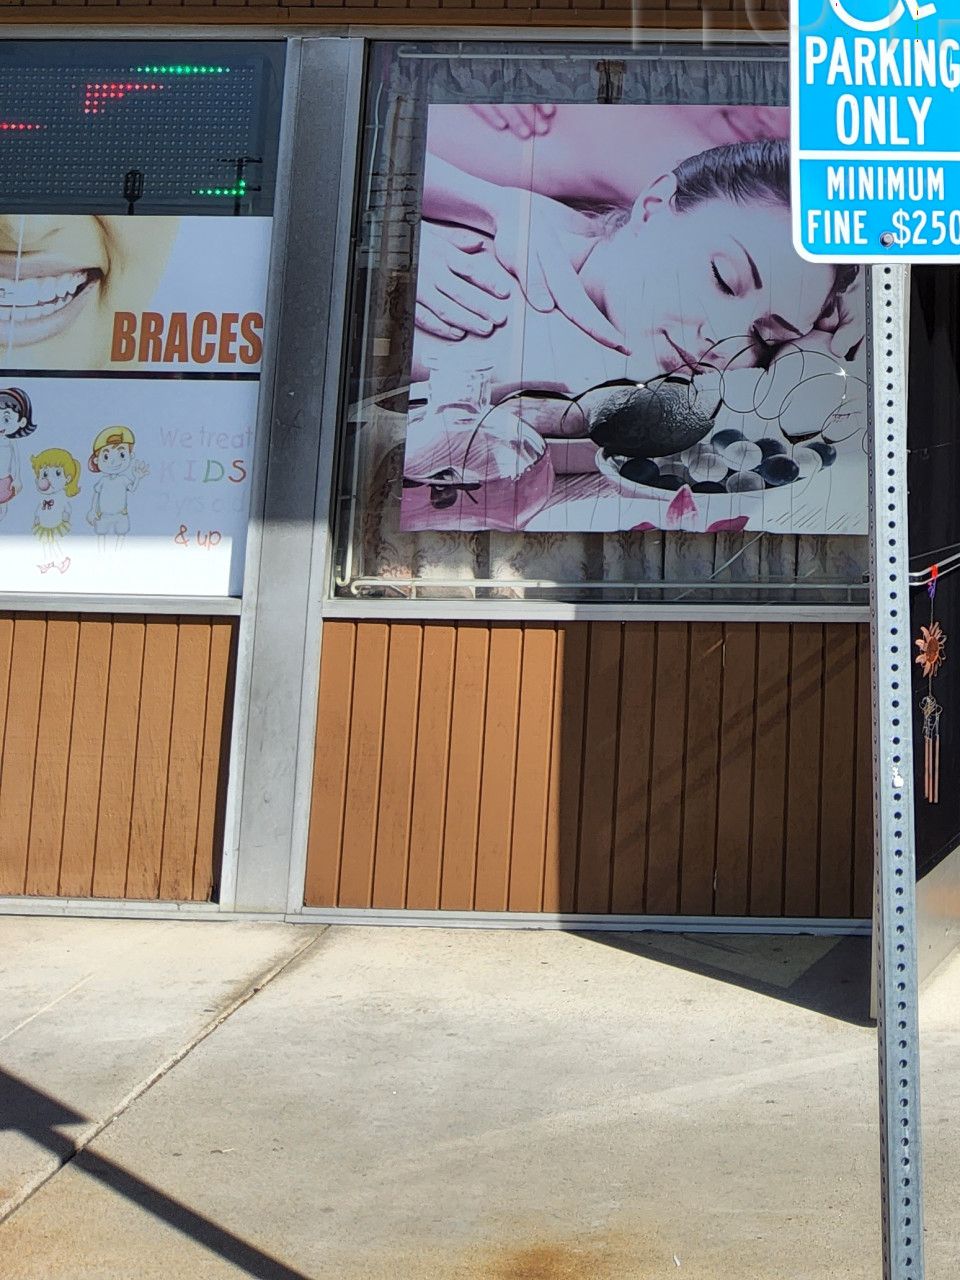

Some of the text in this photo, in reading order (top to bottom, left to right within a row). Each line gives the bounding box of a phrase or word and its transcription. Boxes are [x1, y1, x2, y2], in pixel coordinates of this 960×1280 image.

[835, 93, 933, 146] ONLY
[826, 165, 945, 201] MINIMUM
[807, 209, 868, 245] FINE
[110, 311, 264, 364] BRACES
[160, 458, 247, 483] KIDS
[174, 524, 222, 551] & up
